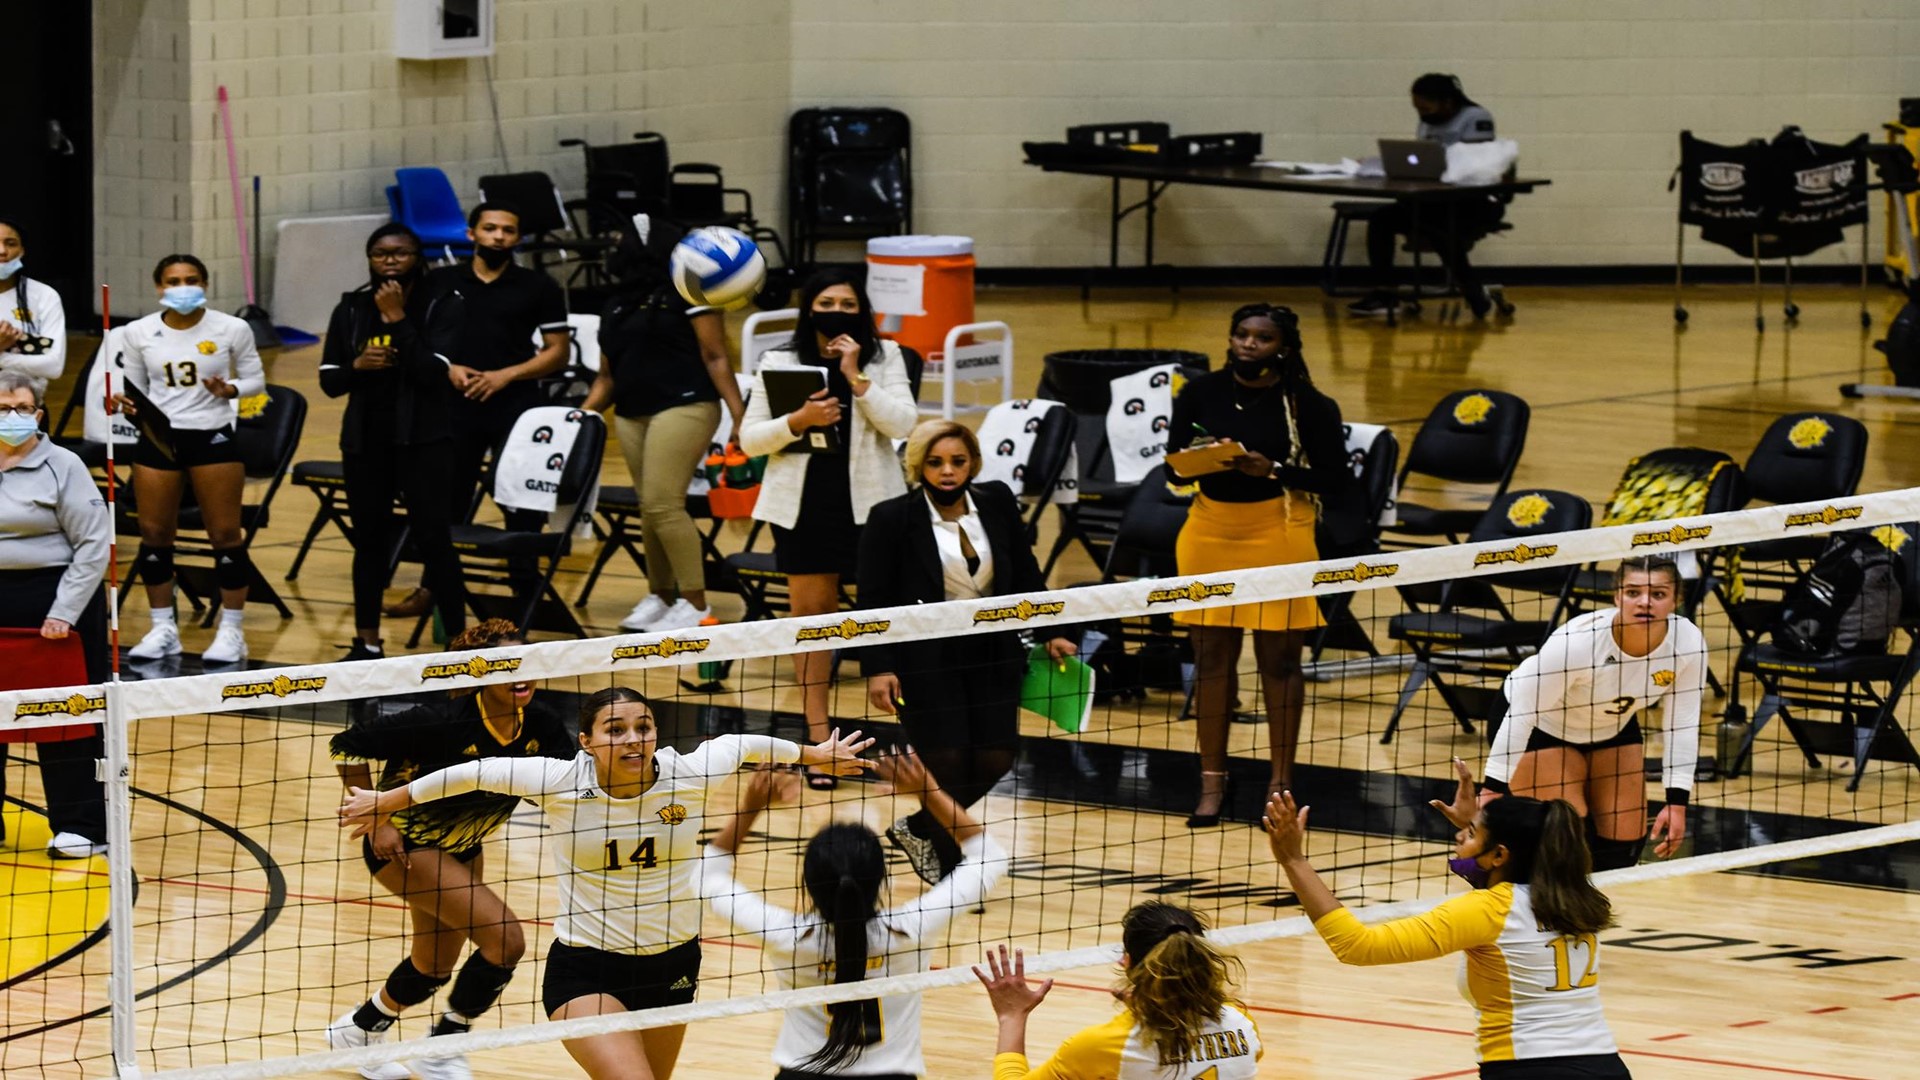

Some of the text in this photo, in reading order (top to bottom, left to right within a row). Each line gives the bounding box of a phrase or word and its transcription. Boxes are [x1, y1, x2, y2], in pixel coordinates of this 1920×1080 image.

[164, 361, 198, 388] 13
[612, 639, 709, 659] GOLDEN LIONS
[422, 658, 521, 678] GOLDEN LIONS
[222, 677, 326, 698] GOLDEN LIONS
[16, 700, 69, 716] GOLDEN
[1604, 696, 1636, 715] 3
[605, 836, 658, 870] 14
[1545, 932, 1599, 992] 12
